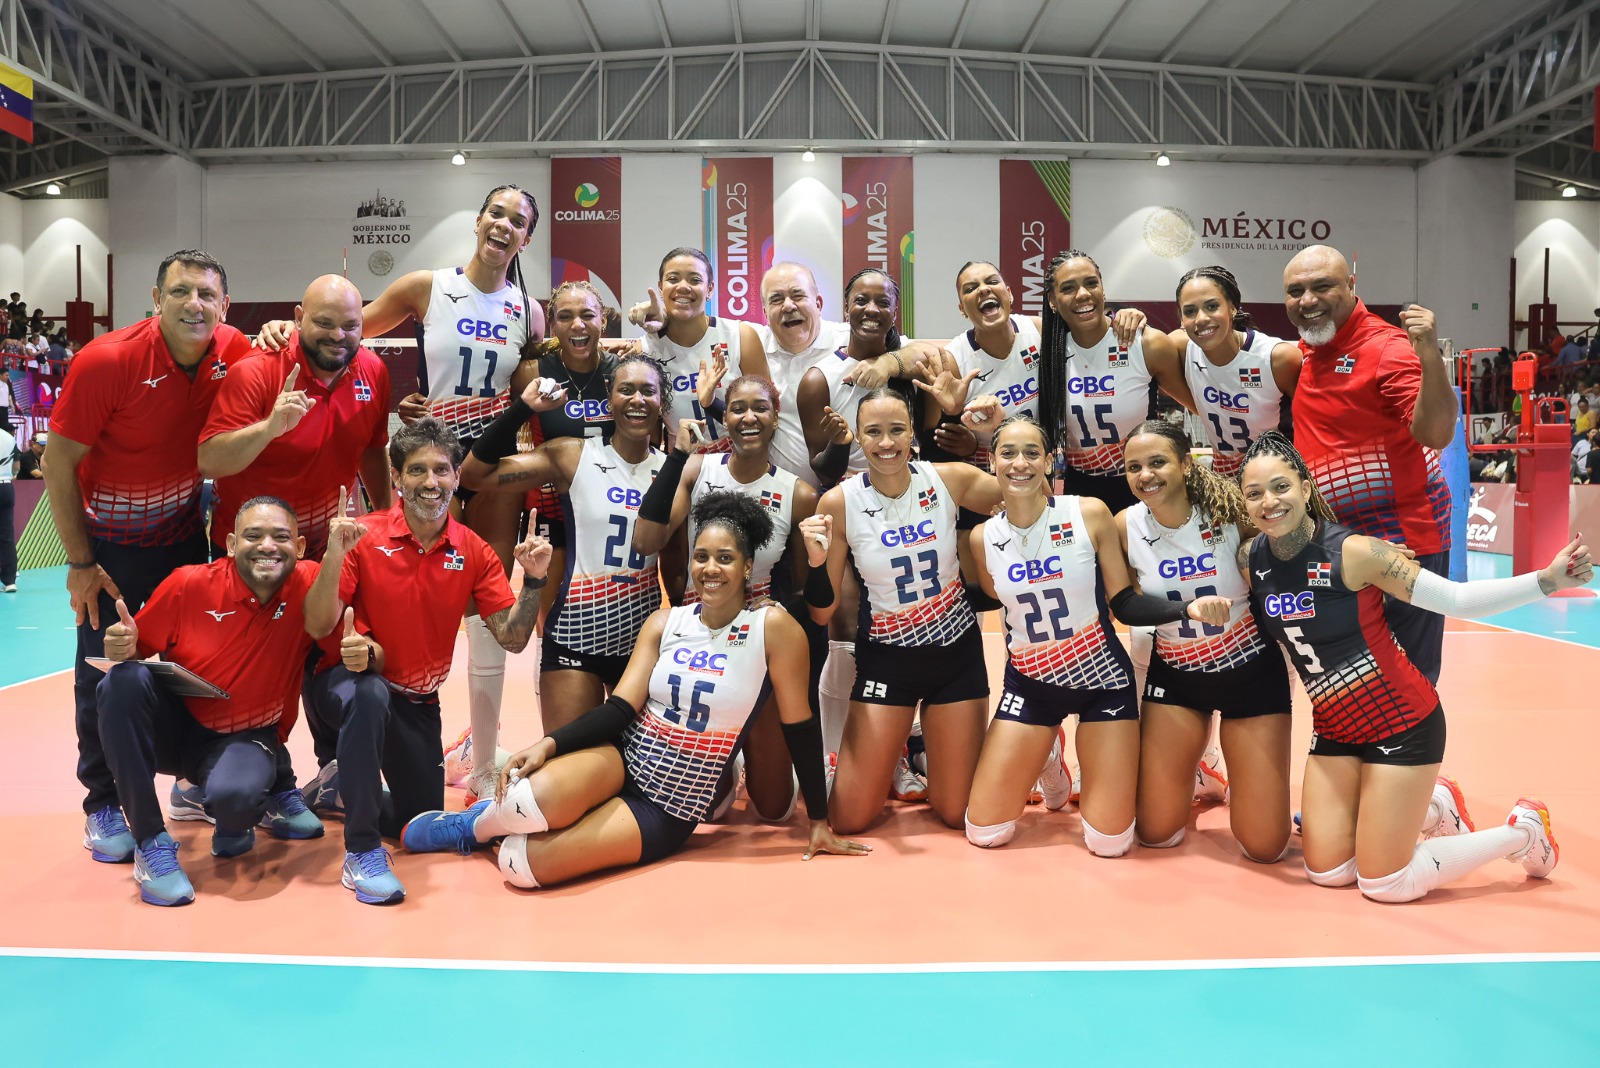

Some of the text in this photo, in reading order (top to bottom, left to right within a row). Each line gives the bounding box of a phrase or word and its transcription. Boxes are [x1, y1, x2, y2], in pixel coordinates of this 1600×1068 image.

[352, 224, 398, 232] GOBIERNO
[352, 231, 411, 245] MÉXICO
[866, 182, 888, 274] IMA25
[1201, 210, 1331, 241] MÉXICO
[1201, 242, 1255, 250] PRESIDENCIA
[1269, 243, 1280, 251] LA
[1282, 242, 1311, 251] REPÚB
[1022, 220, 1045, 317] IMA25
[456, 317, 508, 341] GBC
[454, 346, 498, 397] 11
[1067, 374, 1115, 395] GBC
[994, 376, 1039, 407] GBC
[1203, 385, 1250, 409] GBC
[1070, 403, 1121, 448] 15
[1207, 412, 1255, 454] 13
[606, 486, 643, 507] GB
[880, 519, 936, 548] GBC
[1055, 538, 1073, 547] DOM
[890, 548, 942, 605] 23
[1007, 555, 1063, 583] GBC
[1158, 552, 1216, 579] GBC
[1015, 587, 1075, 644] 22
[1265, 591, 1315, 617] GBC
[673, 647, 728, 671] GBC
[1283, 626, 1325, 674] 5
[862, 680, 888, 699] 23
[663, 673, 716, 734] 16
[999, 692, 1025, 717] 22
